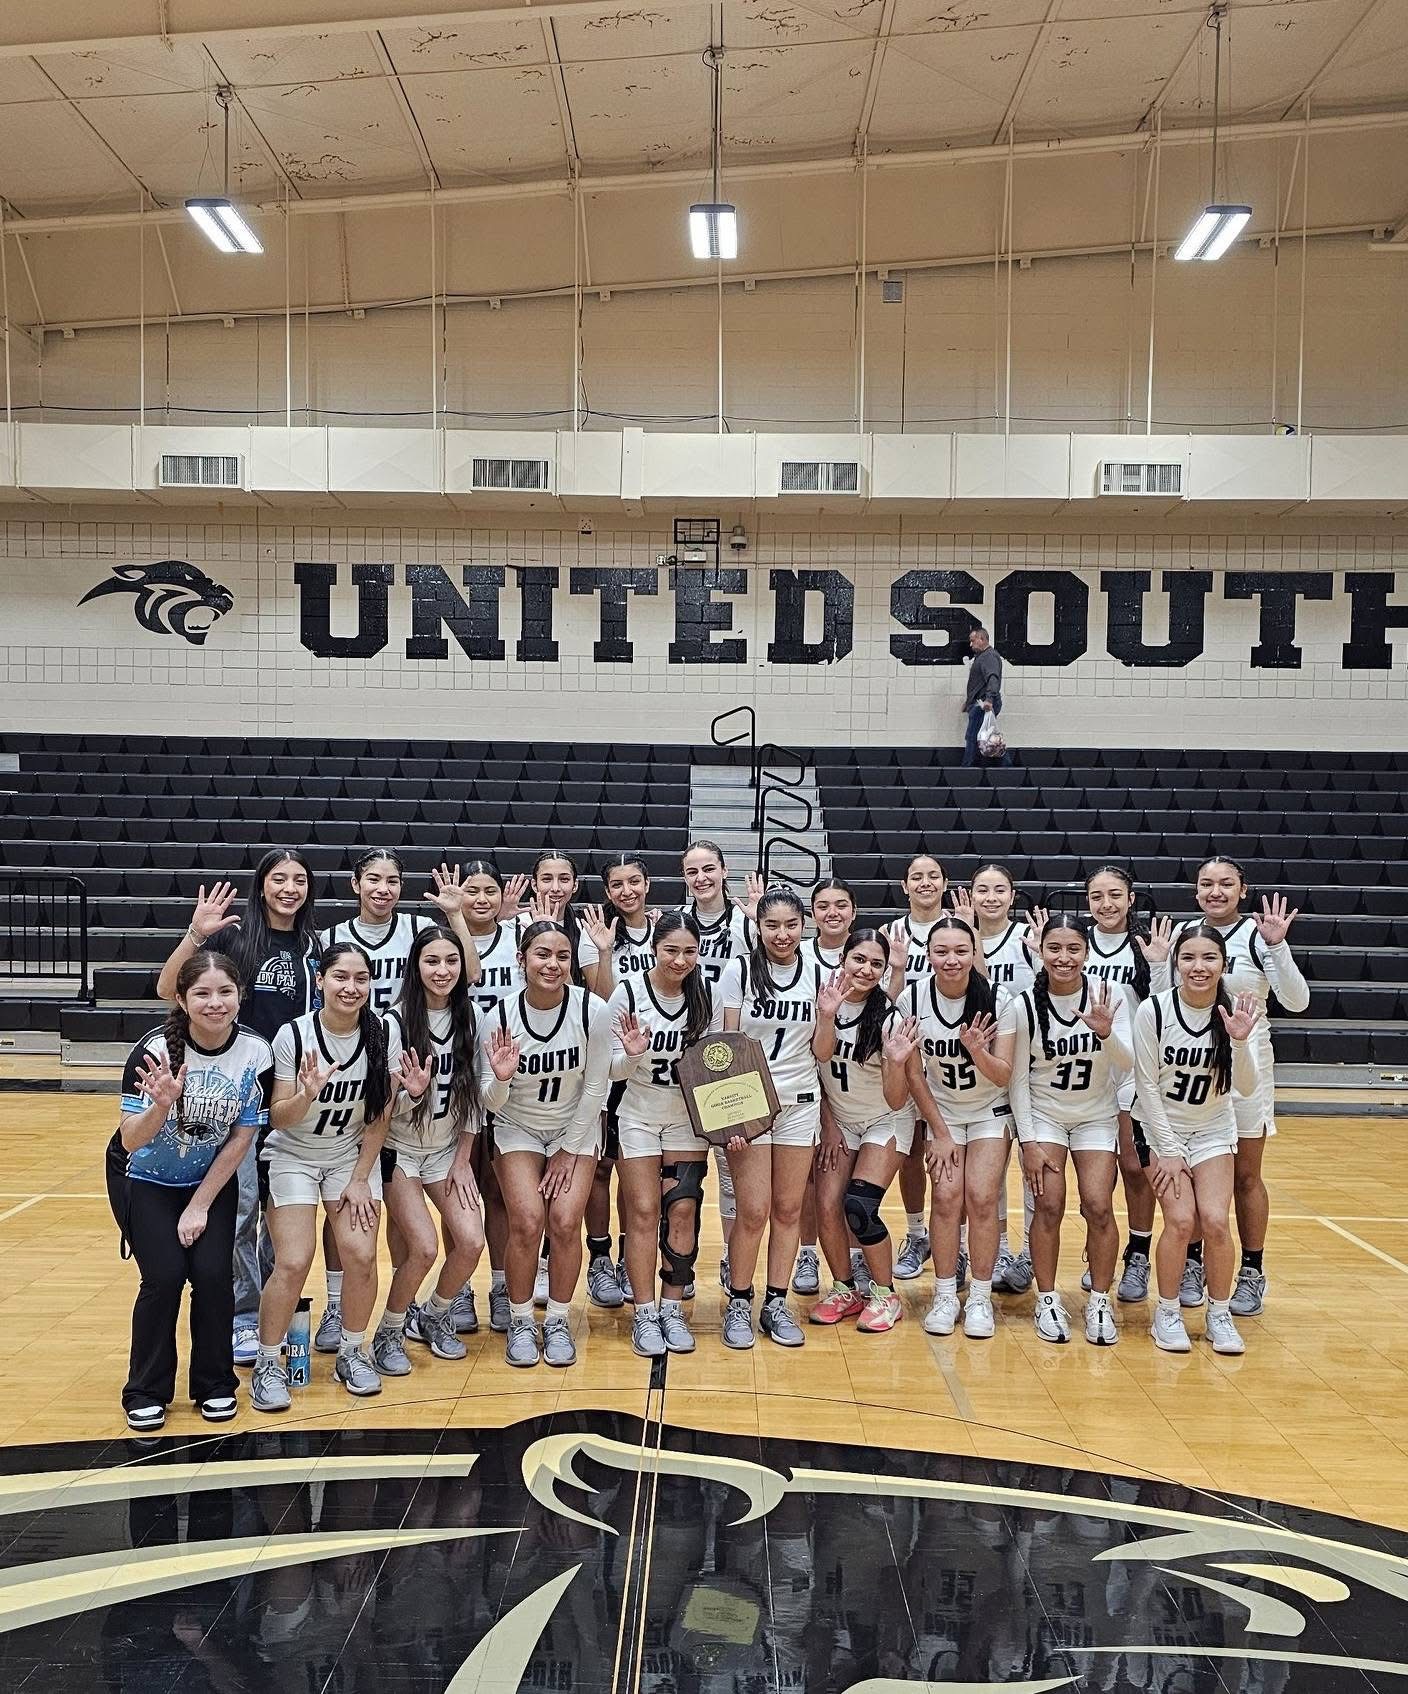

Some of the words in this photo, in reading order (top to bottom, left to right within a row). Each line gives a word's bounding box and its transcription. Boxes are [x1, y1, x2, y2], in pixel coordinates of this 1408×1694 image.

[294, 562, 854, 665] UNITED
[700, 939, 733, 959] UTH
[370, 958, 408, 980] UTH
[474, 966, 512, 988] UTH
[750, 997, 811, 1023] SOUTH
[769, 1027, 786, 1061] 1
[923, 1038, 961, 1058] SOU
[1163, 1045, 1217, 1069] SOUT
[516, 1046, 580, 1075] SOUTH
[1050, 1058, 1093, 1091] 33
[537, 1076, 562, 1102] 11
[830, 1060, 849, 1092] 4
[938, 1061, 977, 1091] 35
[1165, 1070, 1213, 1106] 30
[312, 1108, 354, 1136] 14
